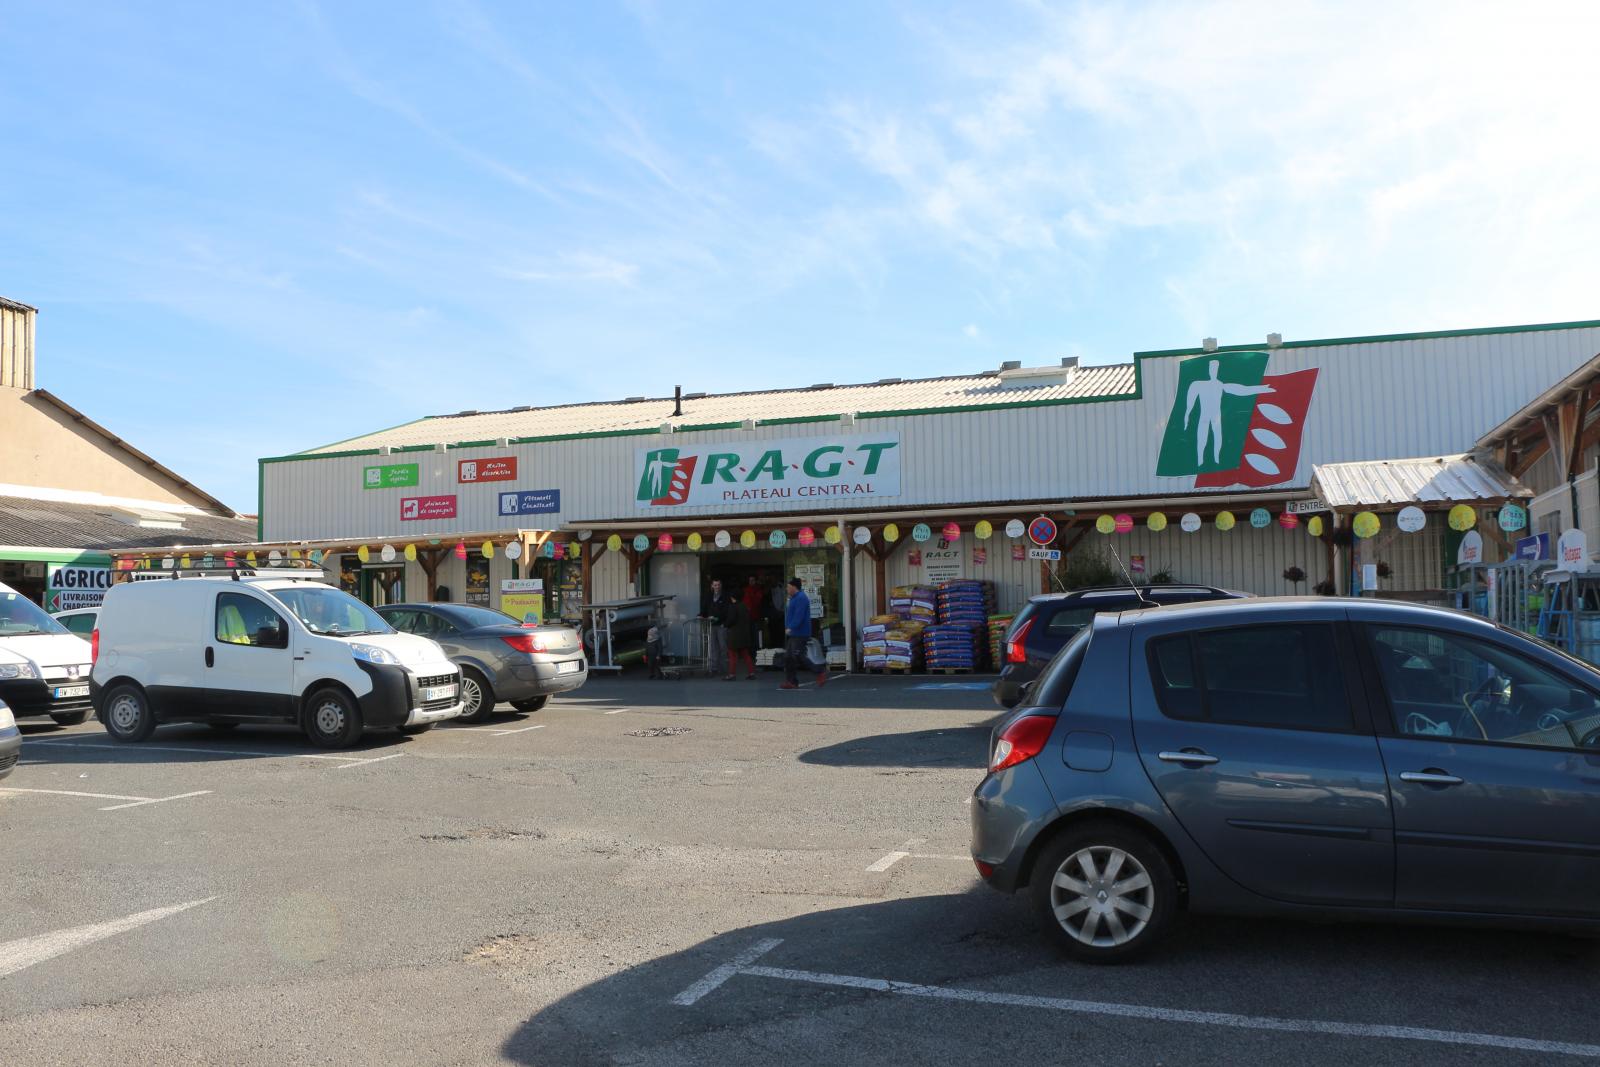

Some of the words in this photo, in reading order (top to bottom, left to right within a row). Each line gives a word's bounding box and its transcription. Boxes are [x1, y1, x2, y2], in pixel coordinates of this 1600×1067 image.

[723, 487, 791, 501] PLATEAU
[797, 483, 875, 497] CENTRAL
[1300, 501, 1328, 511] ENTRE
[926, 551, 960, 559] RAGT
